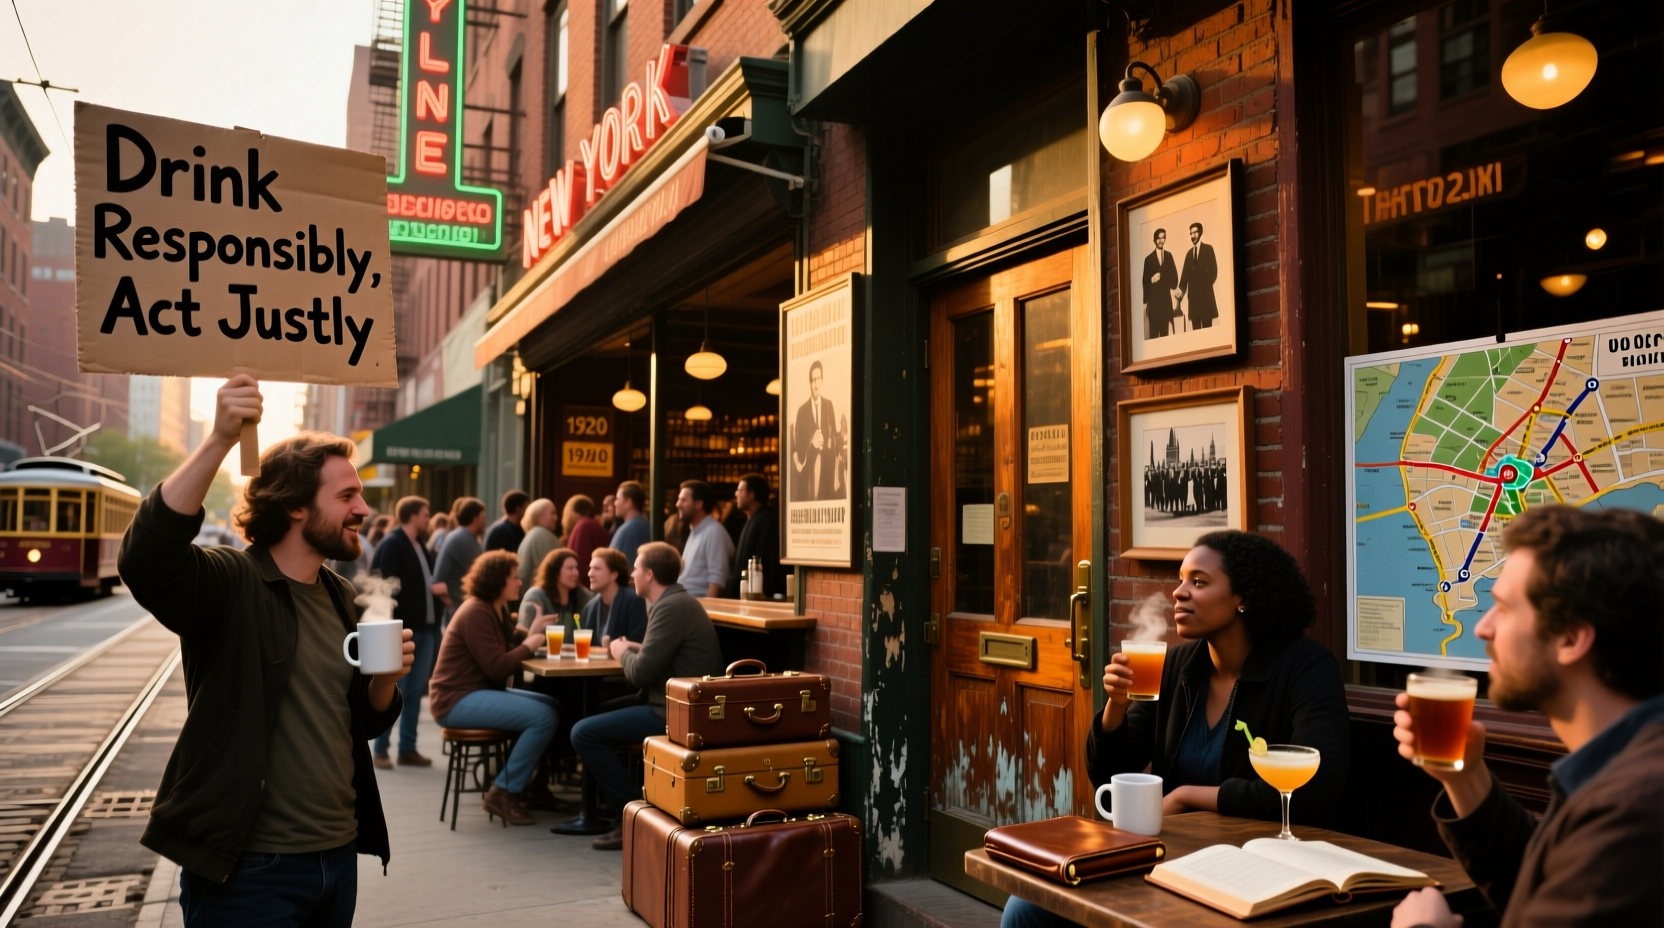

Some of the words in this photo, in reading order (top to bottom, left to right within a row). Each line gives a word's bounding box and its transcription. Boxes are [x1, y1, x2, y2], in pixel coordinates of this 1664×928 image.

[106, 123, 283, 213] Drink
[523, 160, 574, 269] NEW
[579, 43, 670, 203] YORK
[94, 202, 381, 294] Responsibly,
[100, 275, 202, 337] Act
[217, 283, 374, 366] Justly
[566, 415, 608, 436] 1920
